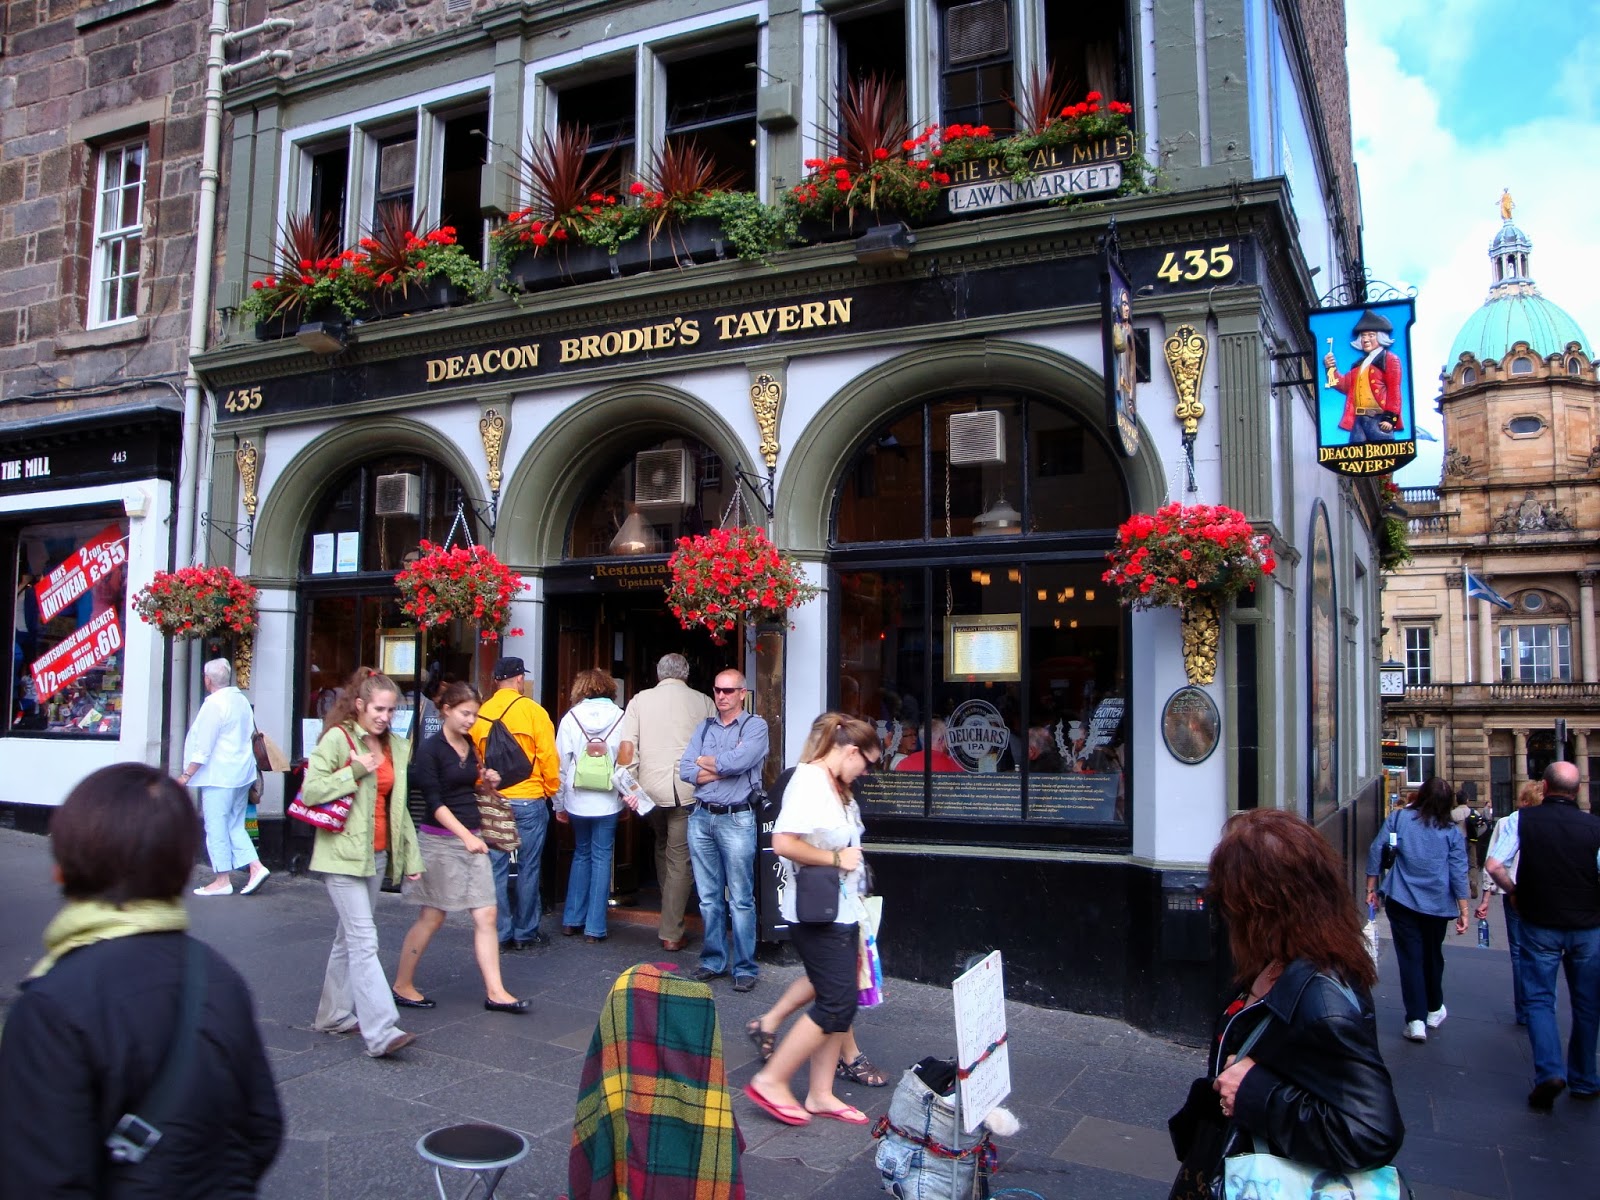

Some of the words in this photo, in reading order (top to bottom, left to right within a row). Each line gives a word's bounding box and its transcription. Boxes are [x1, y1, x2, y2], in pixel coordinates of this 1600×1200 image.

[945, 160, 981, 182] HE
[1072, 135, 1129, 164] MILE
[953, 166, 1115, 210] LAWNMARKET
[1157, 244, 1234, 283] 435
[426, 343, 540, 383] DEACON
[560, 317, 701, 364] BRODIE'S
[714, 297, 853, 341] TAVERN
[224, 386, 263, 413] 435
[111, 451, 127, 463] 443
[1319, 445, 1363, 462] DEACON
[1365, 441, 1415, 459] BRODIE'S
[1, 460, 21, 480] THE
[25, 457, 51, 478] MILL
[1338, 458, 1396, 473] TAVERN
[79, 547, 90, 567] 2
[88, 544, 102, 561] FOR
[595, 563, 673, 577] Restaura
[618, 576, 664, 590] Upstairs
[41, 570, 88, 620] KNITWEAR
[33, 634, 77, 674] KNIGHTSBRIDGE
[75, 625, 91, 642] WAX
[90, 607, 115, 634] JACKETS
[35, 671, 59, 694] 1/2
[56, 664, 75, 684] PRICE
[74, 650, 95, 675] NOW
[93, 623, 121, 661] £60
[949, 727, 1005, 745] DEUCHARS
[968, 743, 985, 751] IPA
